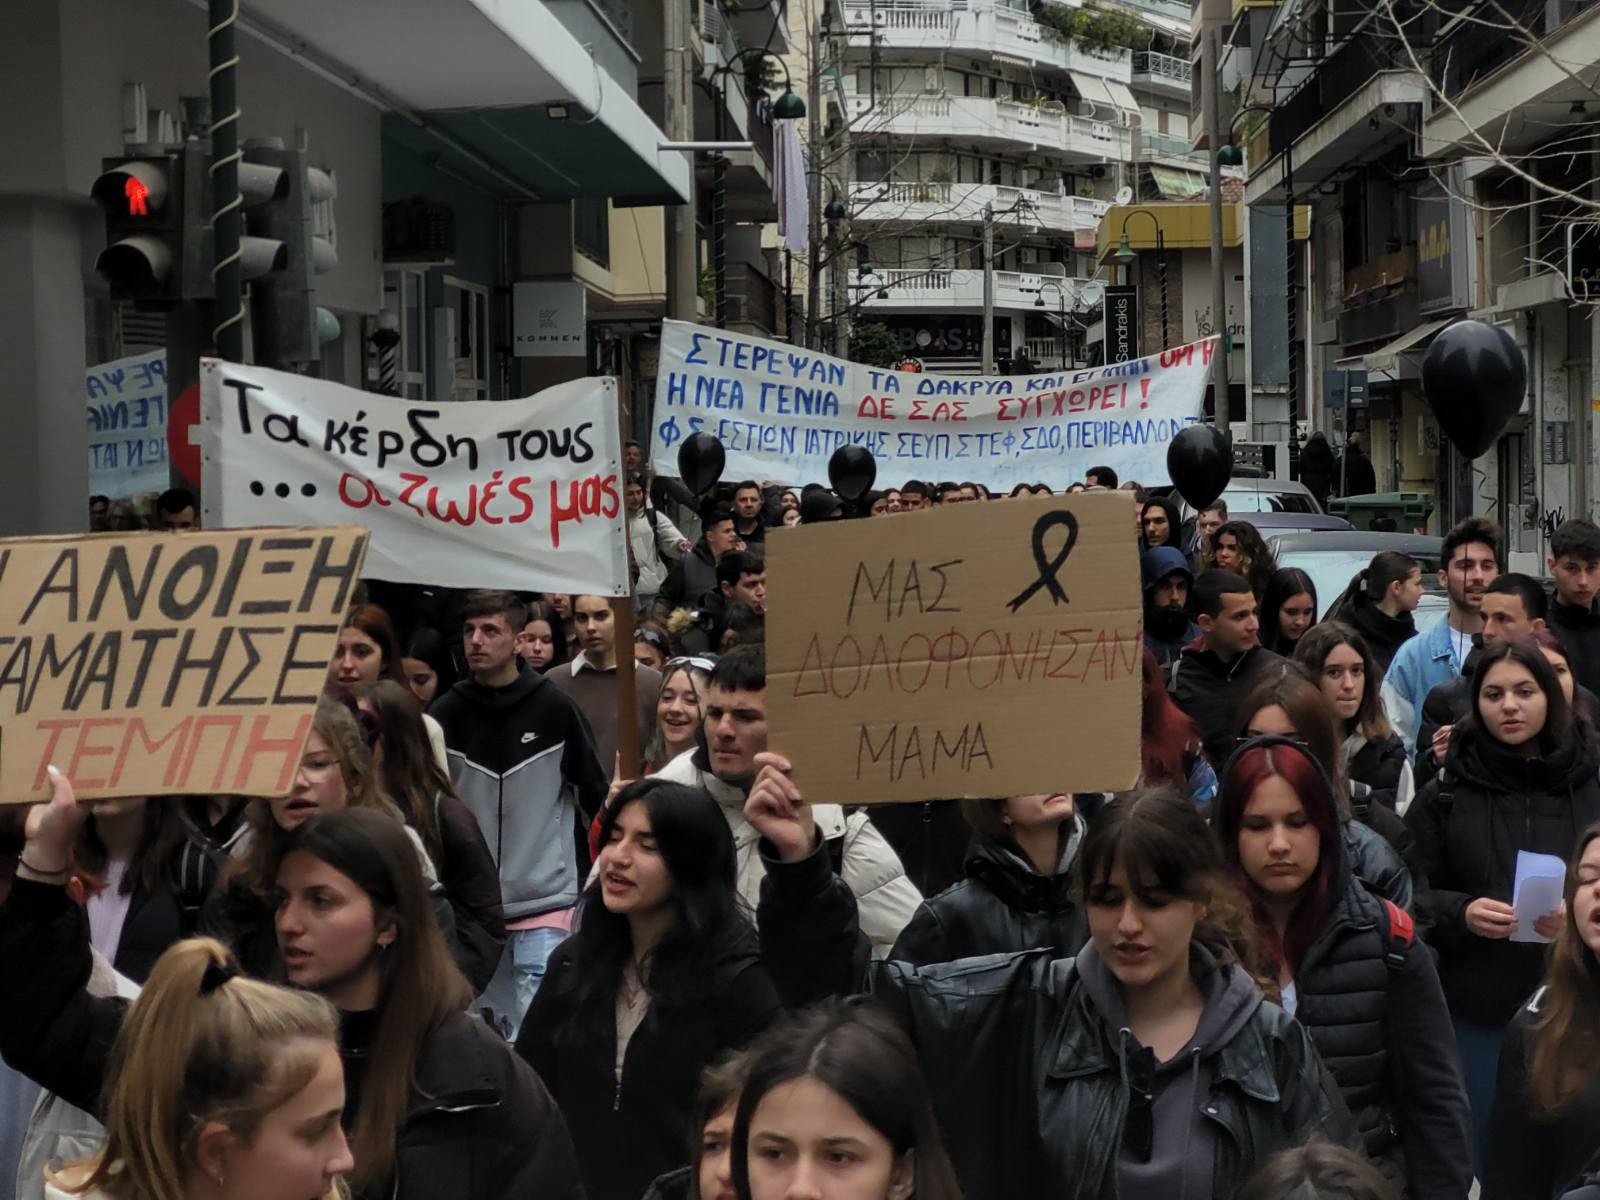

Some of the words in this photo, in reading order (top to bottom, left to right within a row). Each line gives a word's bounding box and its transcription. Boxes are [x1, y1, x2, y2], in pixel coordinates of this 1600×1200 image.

[685, 333, 845, 386] ΣΤΕΡΕΨΑΝ
[868, 371, 900, 393] ΤΑ
[917, 379, 1013, 396] ΔΑΚΡΥΑ
[1026, 376, 1064, 392] ΚΑΙ
[1115, 298, 1128, 363] Sandrakis
[223, 379, 309, 447] Τα
[323, 409, 478, 470] κέρδη
[497, 422, 594, 463] τους
[667, 372, 687, 406] Η
[695, 375, 744, 411] ΝΕΑ
[760, 382, 839, 417] ΓΕΝΙΑ
[857, 394, 897, 420] ΔΕ
[908, 400, 970, 422] ΣΑΣ
[399, 471, 534, 526] ζωές
[550, 474, 620, 549] μας
[18, 536, 366, 625] ΑΝΟΙΞΗ
[847, 559, 963, 625] ΜΑΣ
[793, 626, 1141, 697] ΔΟΛΟΦΟΝΗΣΑΝ
[32, 714, 314, 791] ΤΕΜΠΗ
[856, 722, 993, 782] ΜΑΜΑ
